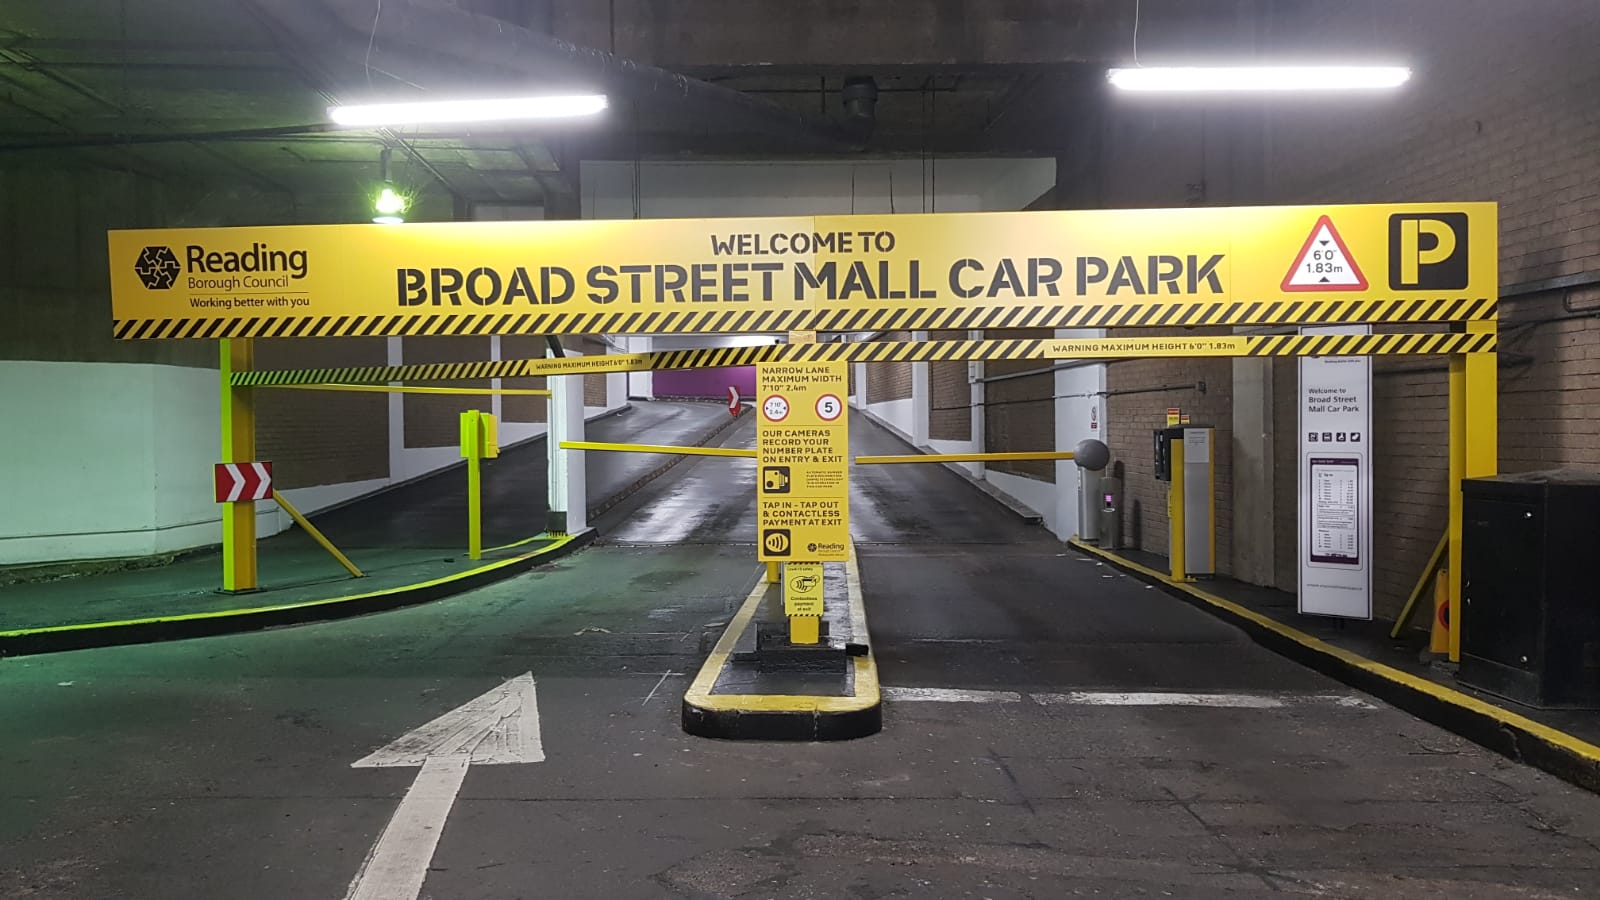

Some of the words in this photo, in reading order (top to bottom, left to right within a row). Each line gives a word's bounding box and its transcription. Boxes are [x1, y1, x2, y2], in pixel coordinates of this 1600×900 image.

[711, 231, 853, 256] WELCOME
[858, 231, 896, 253] TO
[1400, 219, 1456, 285] P
[186, 243, 307, 279] Reading
[1306, 262, 1343, 274] 1.83m
[188, 276, 240, 291] Borough
[243, 275, 289, 288] Council
[397, 266, 576, 306] BROAD
[587, 263, 784, 304] STREET
[793, 259, 937, 300] MALL
[948, 257, 1063, 299] CAR
[1076, 254, 1225, 296] PARK
[190, 298, 232, 309] Working
[234, 297, 264, 307] better
[266, 297, 289, 307] with
[291, 298, 310, 308] you
[1053, 344, 1099, 353] WARNING
[1101, 343, 1150, 352] MAXIMUM
[1151, 342, 1187, 350] HEIGHT
[1209, 342, 1236, 350] 1.83m
[536, 362, 561, 370] WARNING
[562, 361, 591, 369] MAXIMUM
[805, 366, 831, 374] LANE
[762, 375, 809, 383] MAXIMUM
[786, 384, 807, 392] 2.4m
[824, 402, 833, 413] 5
[784, 429, 831, 437] CAMERAS
[762, 438, 801, 446] RECORD
[803, 438, 829, 446] YOUR
[800, 501, 818, 509] TAP
[817, 542, 845, 551] Reading
